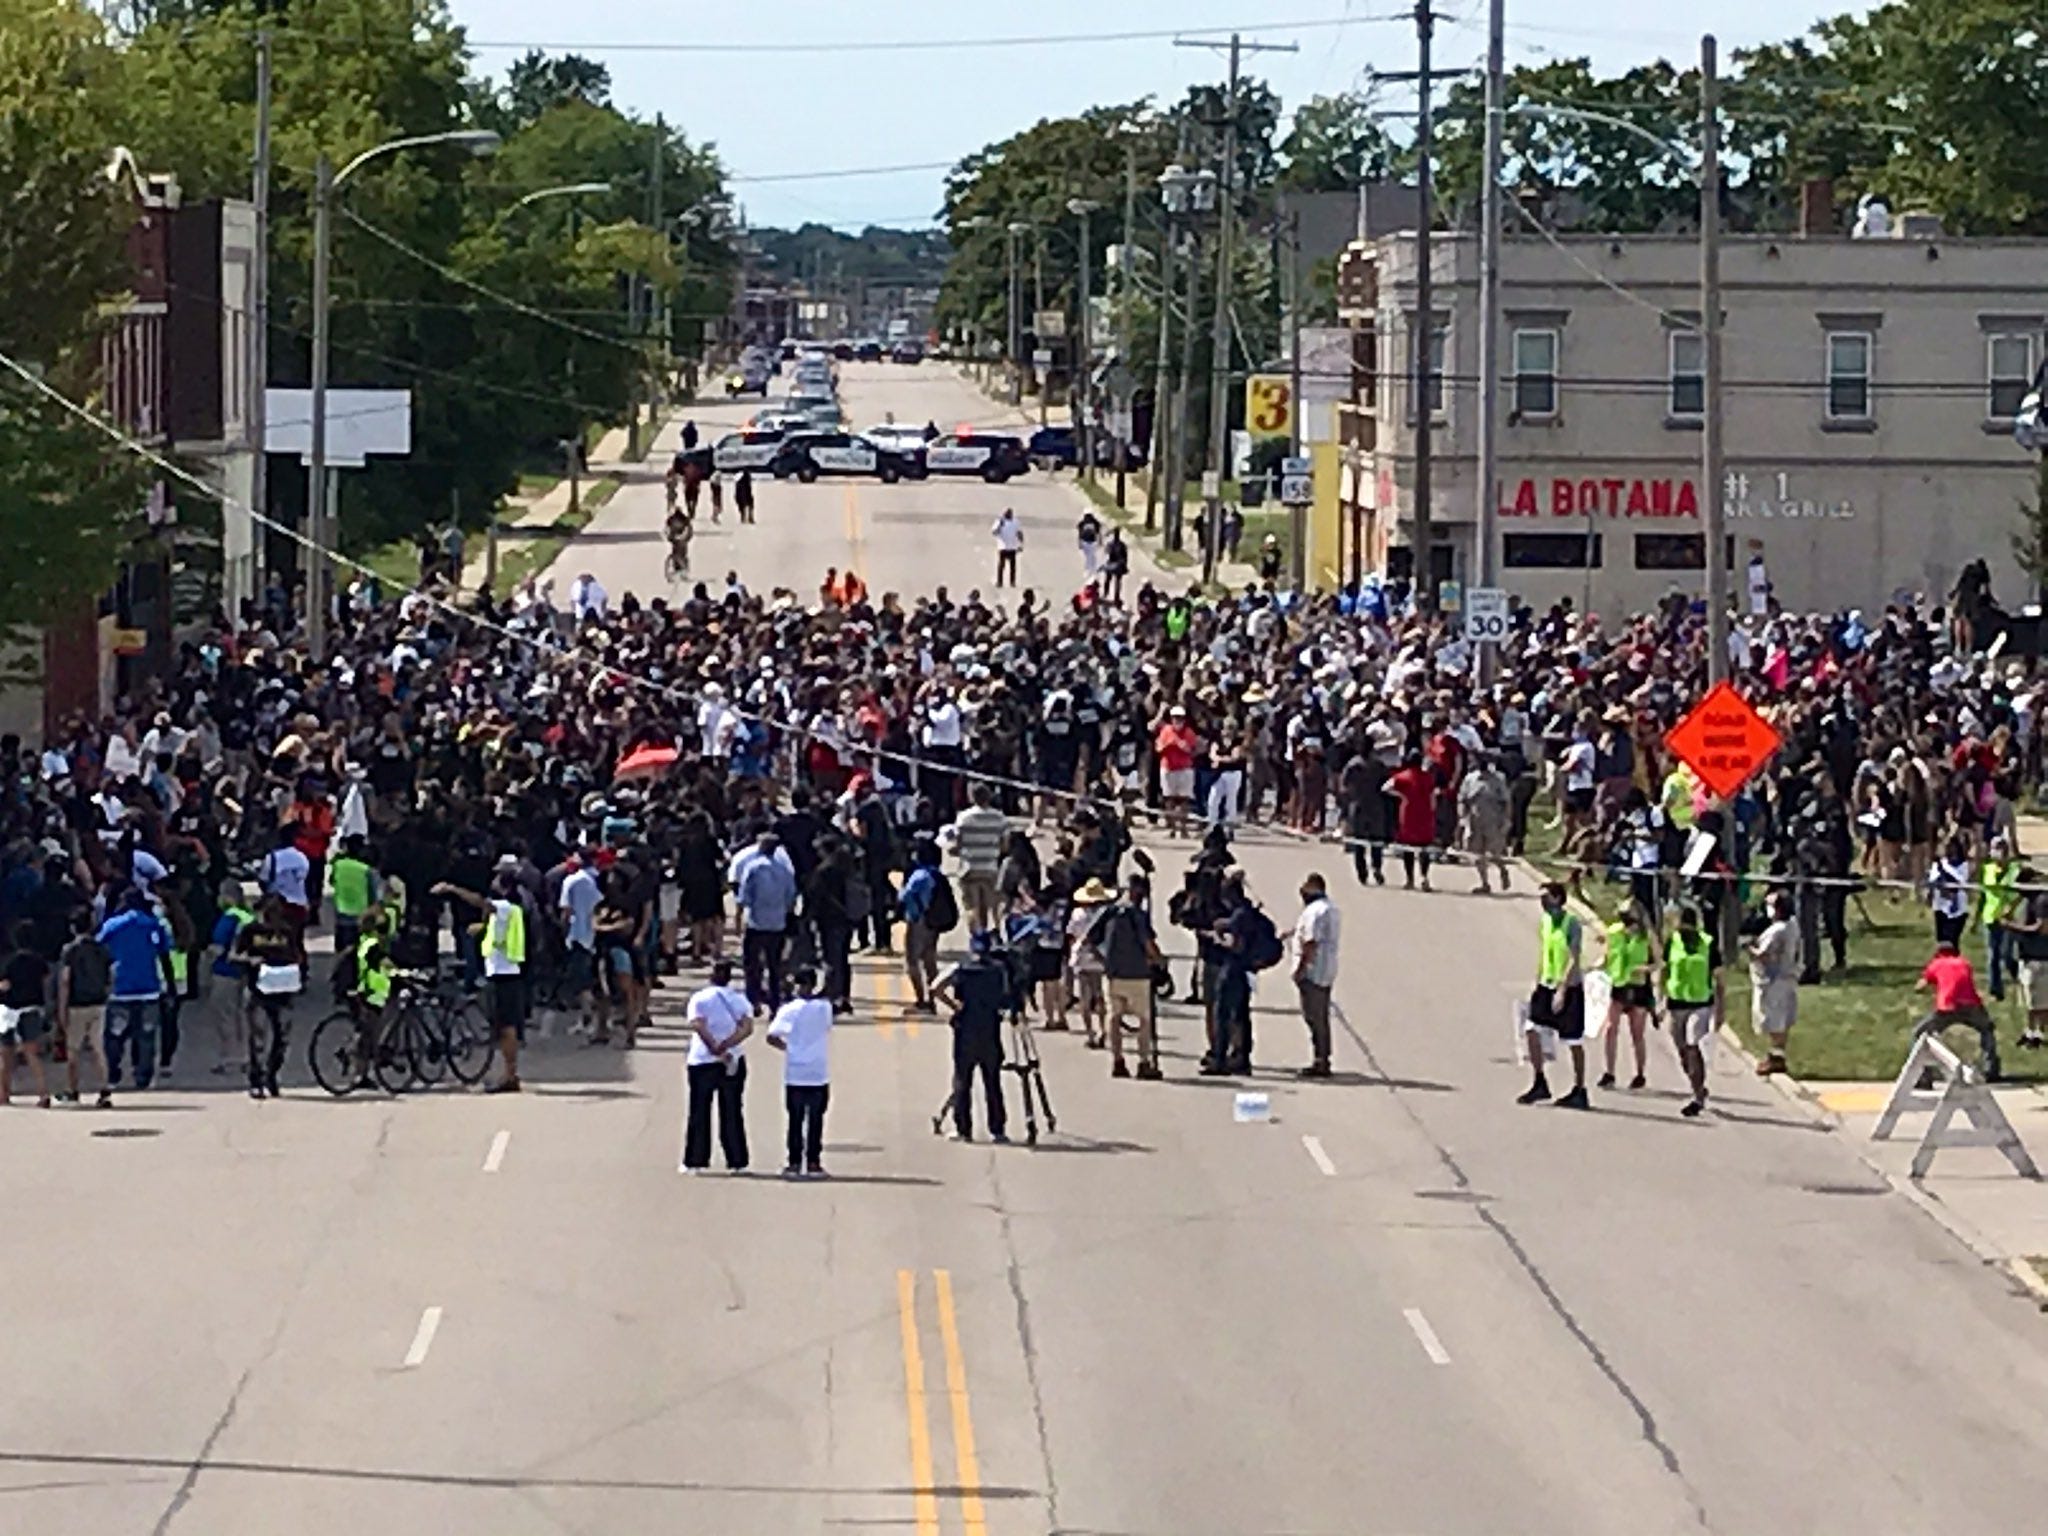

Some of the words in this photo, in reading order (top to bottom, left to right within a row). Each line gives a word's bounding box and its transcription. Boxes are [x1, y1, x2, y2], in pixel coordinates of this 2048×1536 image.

[1497, 478, 1537, 517] LA
[1724, 472, 1750, 499] #
[1776, 472, 1788, 501] 1
[1470, 615, 1504, 637] 30
